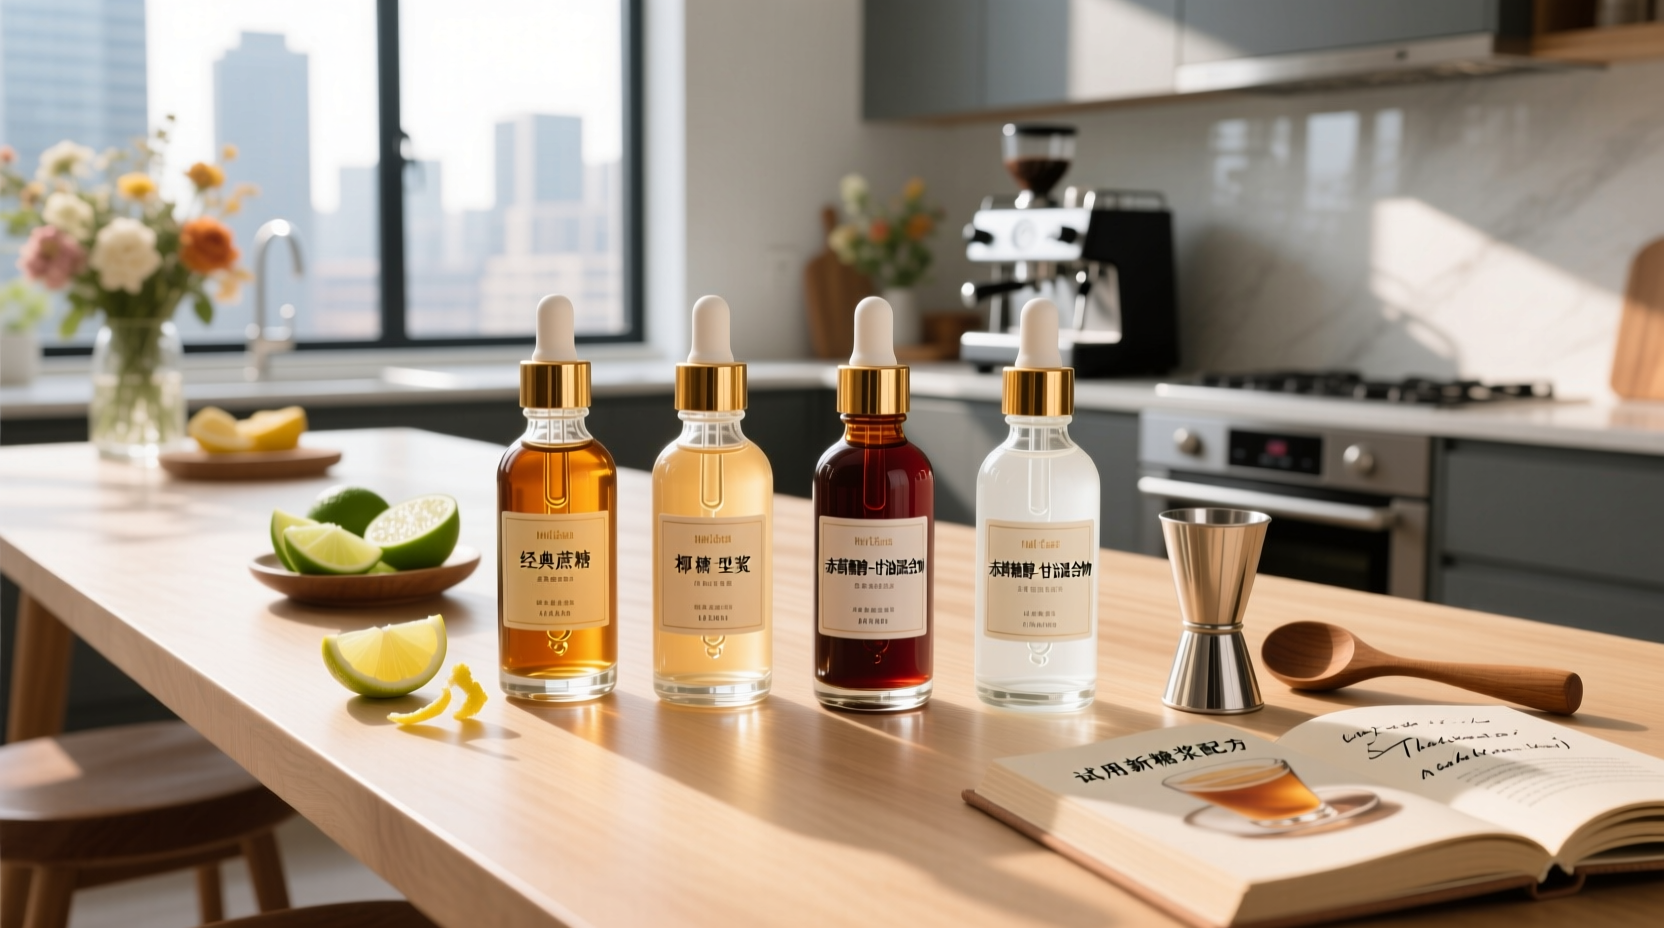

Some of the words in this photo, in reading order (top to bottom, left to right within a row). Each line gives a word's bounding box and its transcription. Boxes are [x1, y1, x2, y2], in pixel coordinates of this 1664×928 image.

[520, 550, 591, 570] 经典蔗糖
[1073, 738, 1247, 783] 试用新糖浆配方
